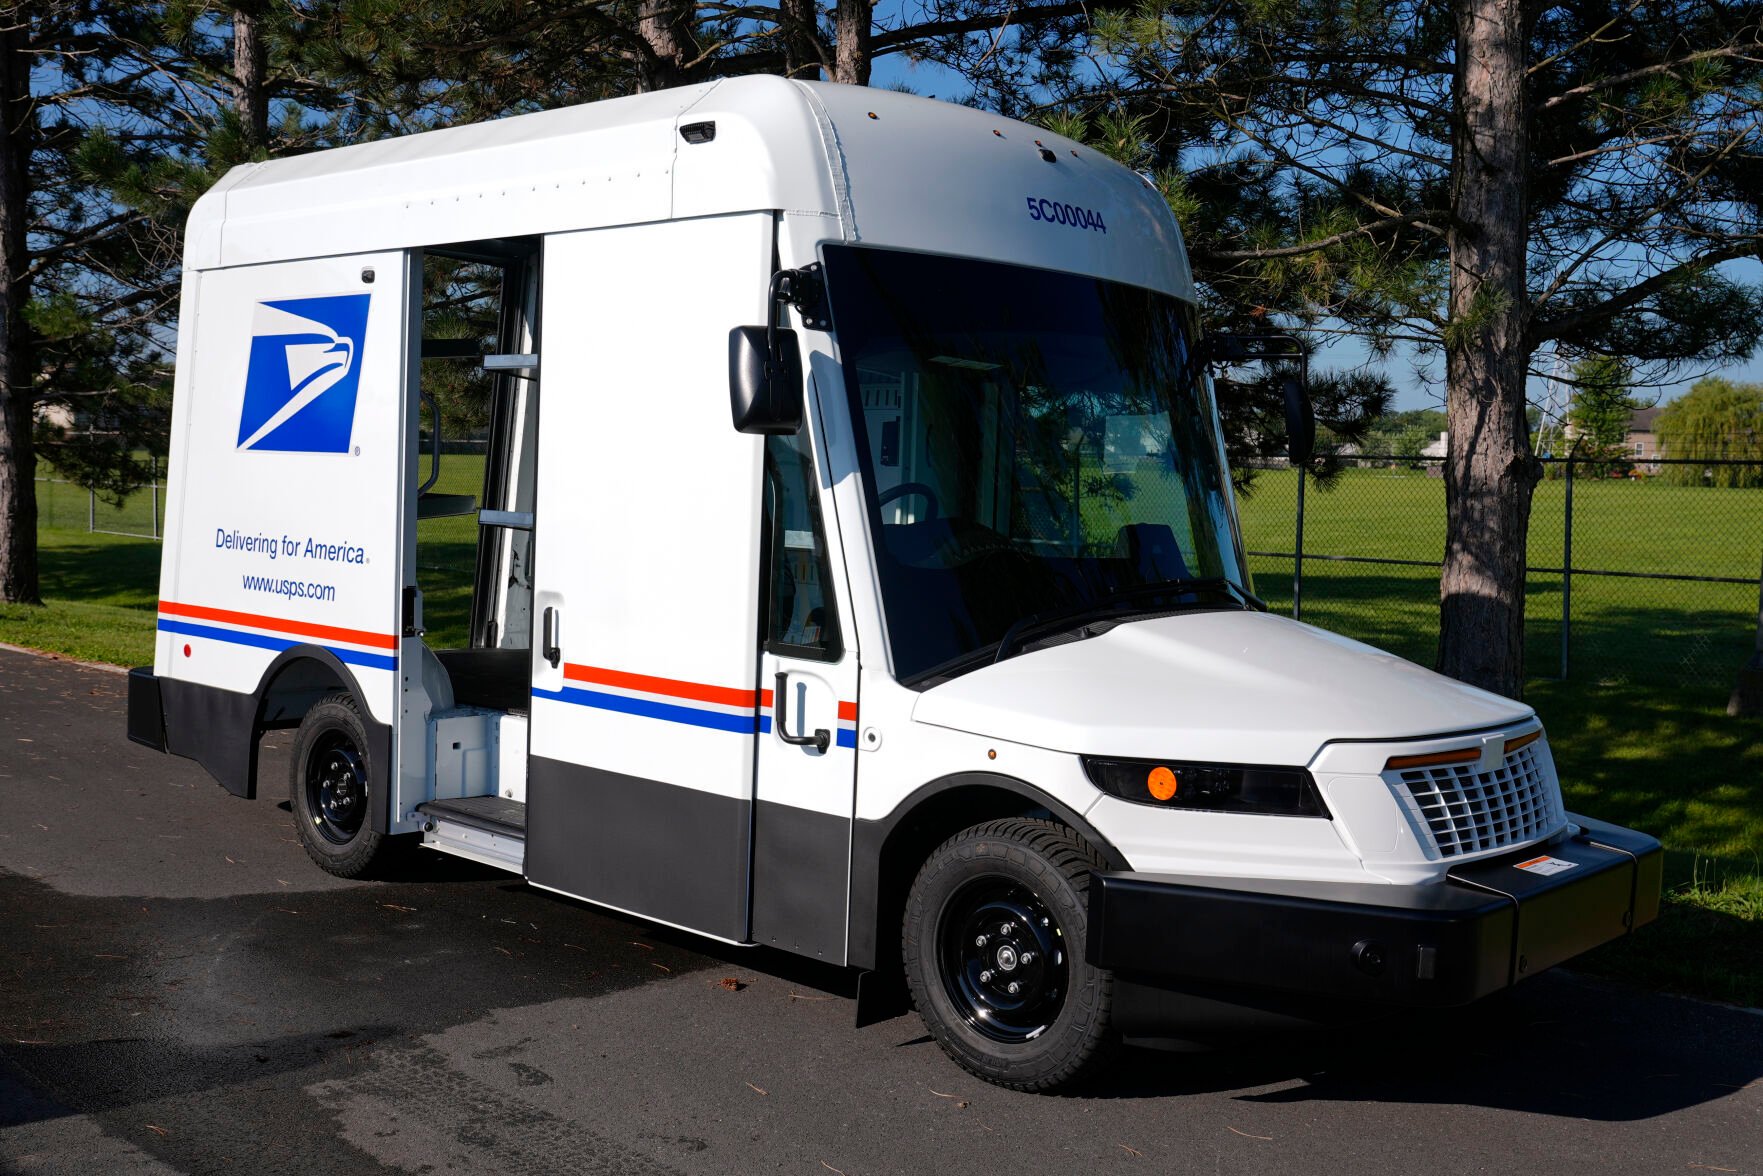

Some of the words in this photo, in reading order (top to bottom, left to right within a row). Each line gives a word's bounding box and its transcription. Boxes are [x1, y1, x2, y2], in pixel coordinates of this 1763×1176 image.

[1026, 196, 1107, 235] 5C00044
[215, 528, 278, 560] Delivering
[281, 534, 301, 557] for
[242, 574, 336, 602] www.usps.com
